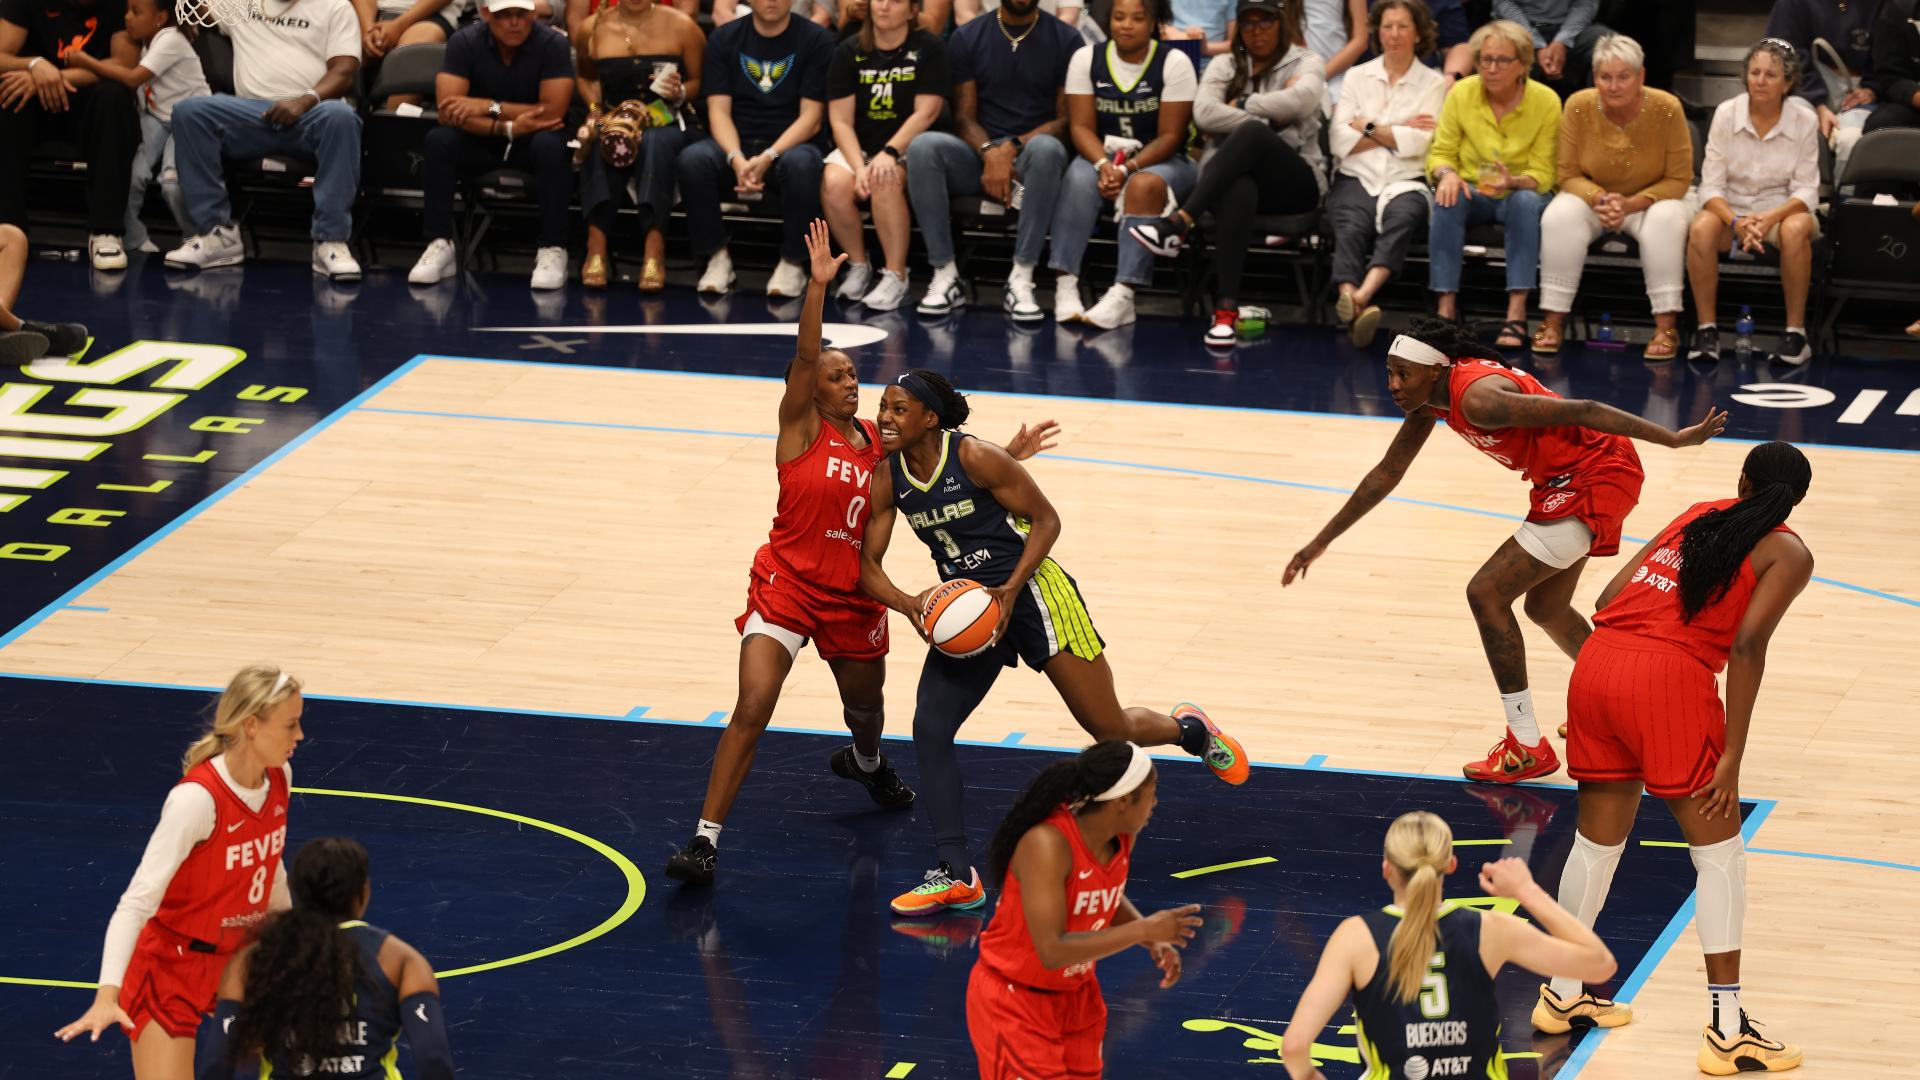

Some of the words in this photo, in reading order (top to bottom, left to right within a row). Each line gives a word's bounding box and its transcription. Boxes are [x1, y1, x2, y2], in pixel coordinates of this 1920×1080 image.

[859, 65, 915, 84] TEXAS
[870, 82, 894, 110] 24
[1096, 96, 1159, 113] DALLAS
[1119, 116, 1134, 138] 5
[0, 384, 309, 562] DALLAS
[825, 456, 873, 494] FEV
[846, 495, 866, 529] 0
[906, 498, 976, 530] DALLAS
[933, 528, 961, 559] 3
[1643, 572, 1678, 593] AT&T
[248, 865, 267, 905] 8
[1419, 951, 1450, 1019] 5
[1405, 1020, 1468, 1049] BUECKERS
[318, 1055, 365, 1074] AT&T
[1430, 1056, 1472, 1077] AT&T
